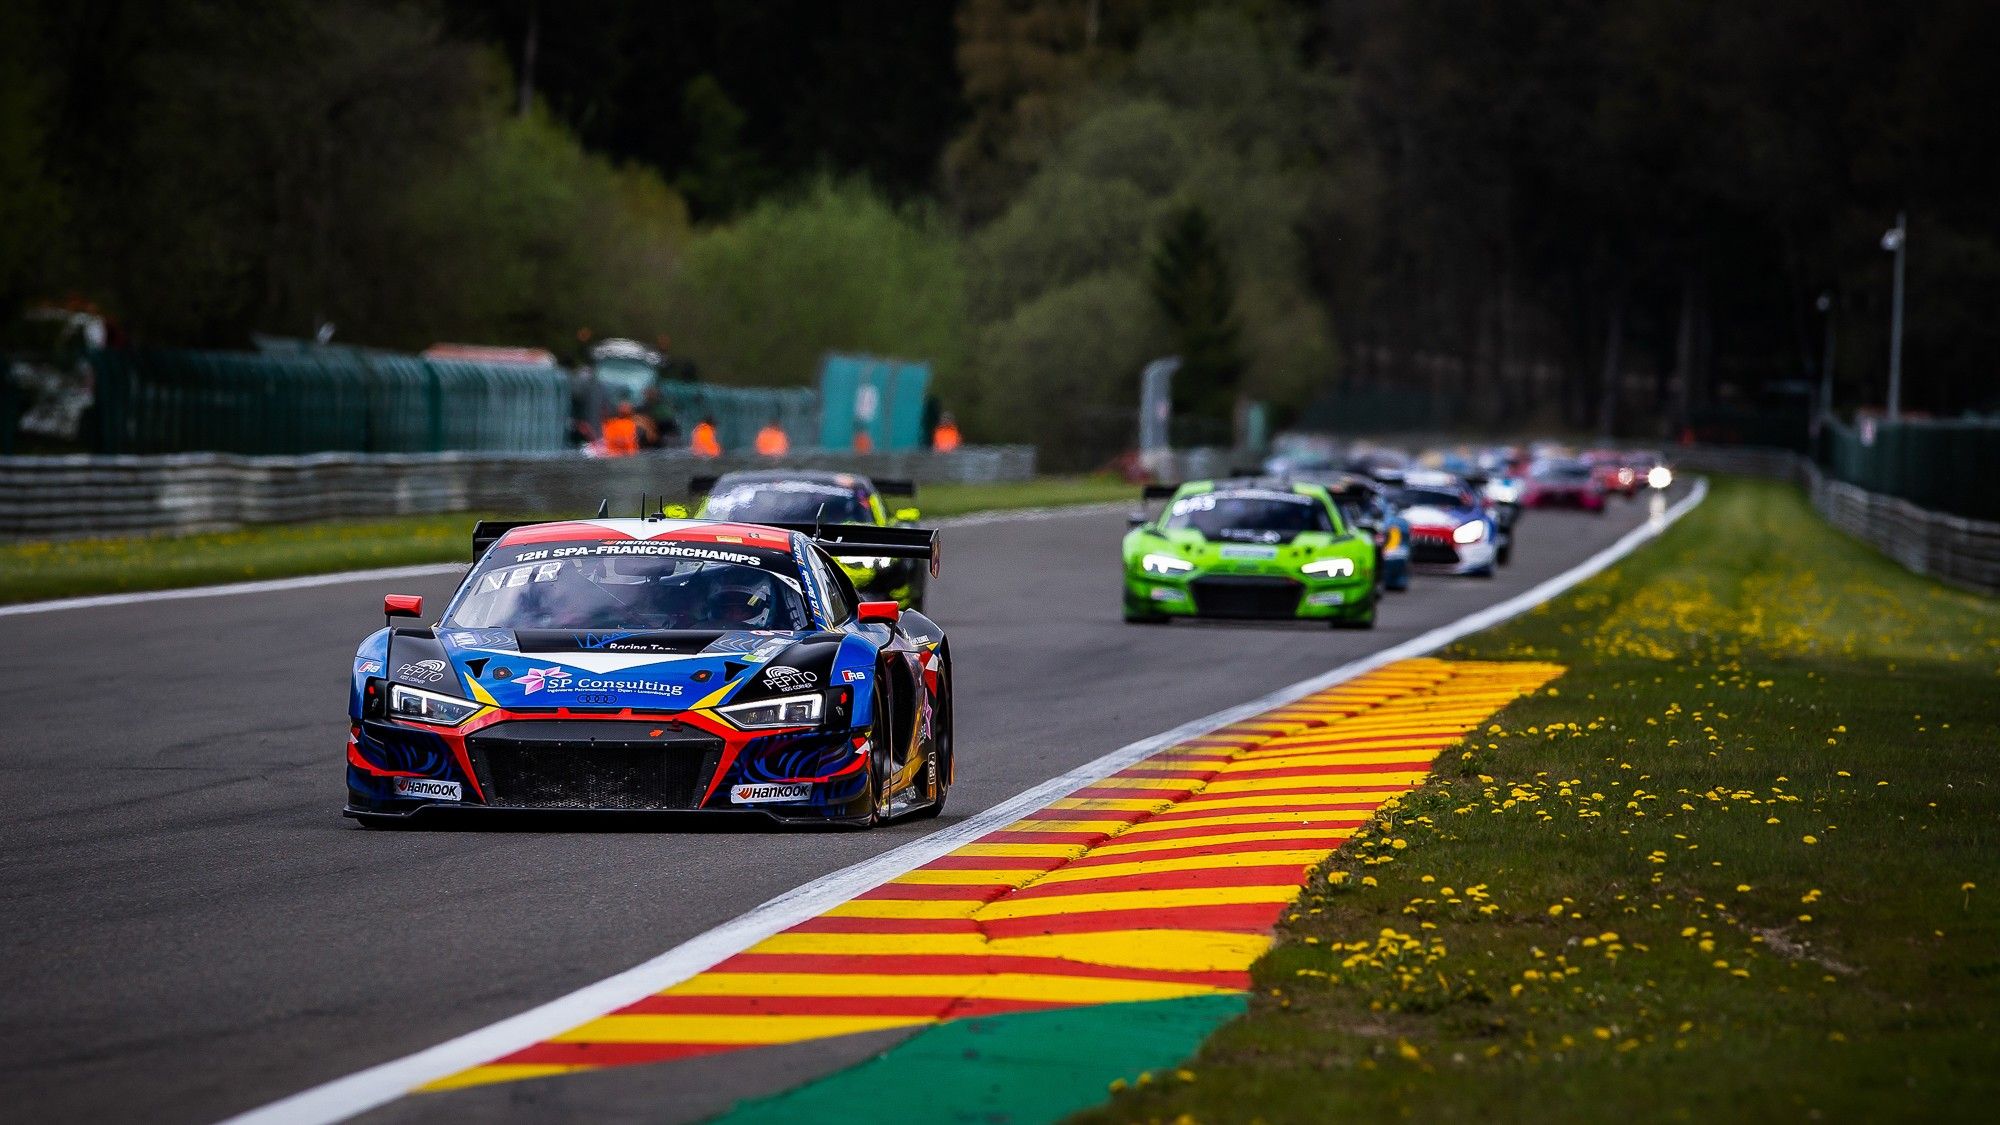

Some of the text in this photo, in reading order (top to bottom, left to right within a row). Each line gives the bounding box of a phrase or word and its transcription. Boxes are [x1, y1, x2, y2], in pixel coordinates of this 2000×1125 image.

[515, 545, 761, 566] 12H SPA-FRANCORCHAMPS
[397, 663, 444, 682] PEPITO
[763, 671, 818, 690] PEPITO
[845, 670, 866, 682] R8
[547, 678, 684, 696] SP Consulting
